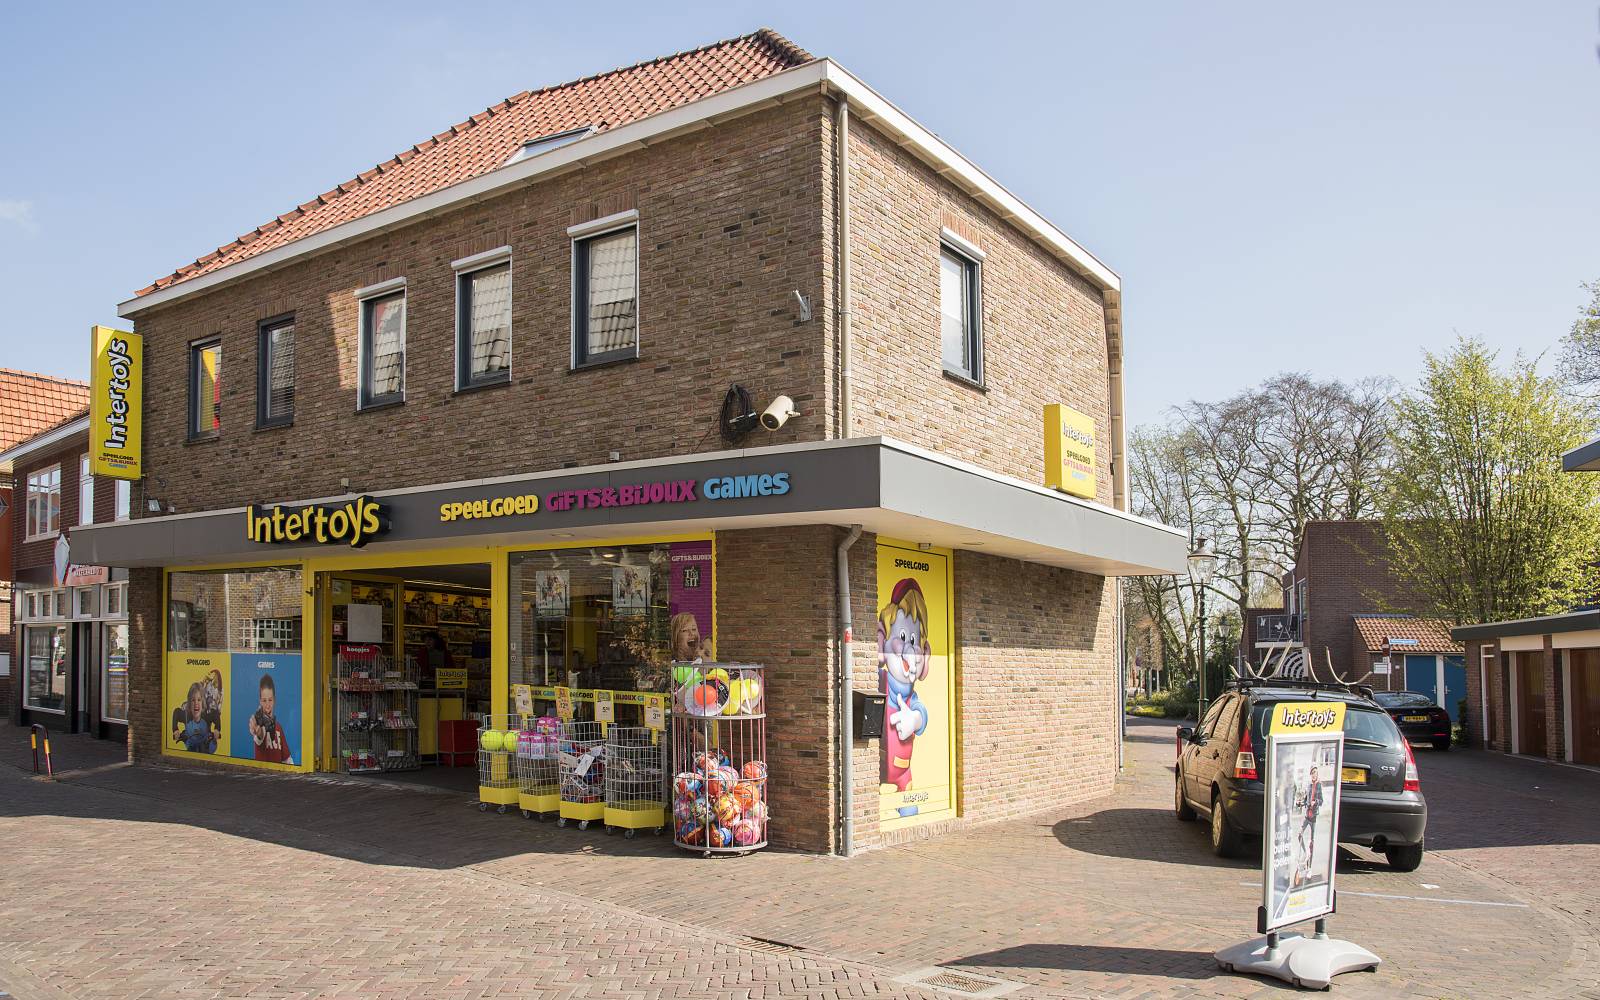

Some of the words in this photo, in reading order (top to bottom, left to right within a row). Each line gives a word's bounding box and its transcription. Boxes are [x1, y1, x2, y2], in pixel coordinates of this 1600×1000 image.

[104, 337, 132, 449] Intertoys
[1063, 422, 1094, 448] Intertoys
[247, 497, 382, 546] Intertoys
[1281, 707, 1337, 729] Intertoys
